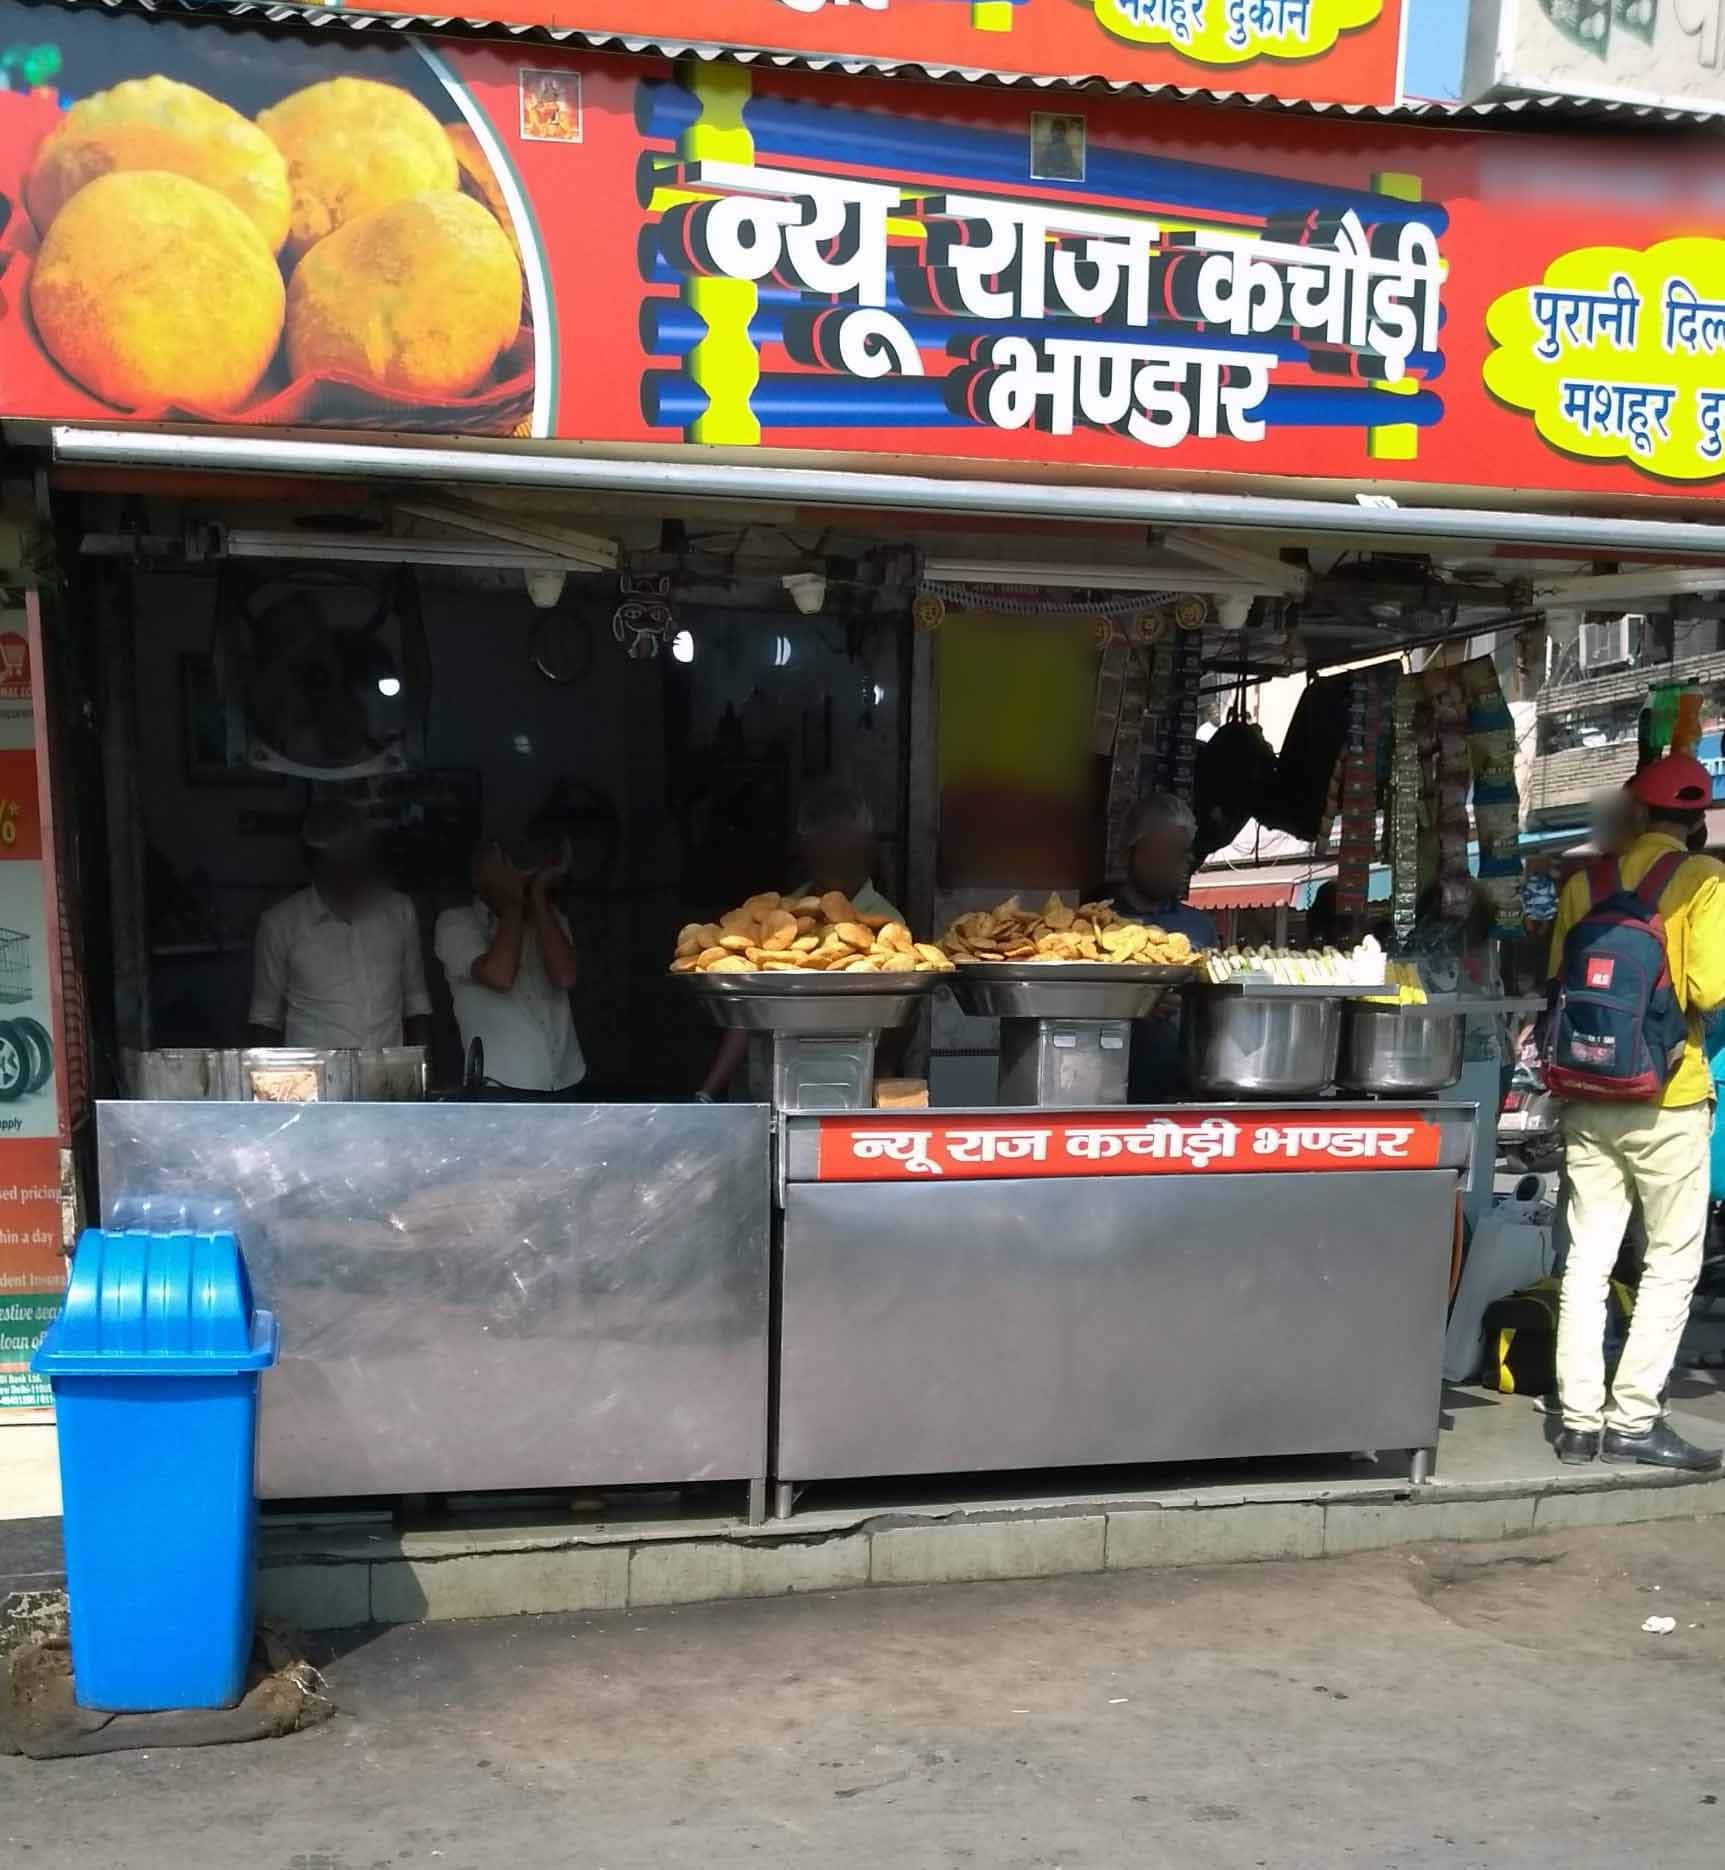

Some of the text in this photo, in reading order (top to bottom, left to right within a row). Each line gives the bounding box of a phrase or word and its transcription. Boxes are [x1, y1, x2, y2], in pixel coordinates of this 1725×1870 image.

[701, 160, 1441, 383] न्यू राज कचौड़ी
[1533, 275, 1641, 358] पुरानी
[988, 336, 1278, 449] भण्डार
[1563, 383, 1677, 452] मशहूर
[0, 1117, 22, 1131] pply
[851, 1117, 1413, 1174] न्यू राज कचौड़ी भण्डार
[21, 1232, 29, 1243] a
[32, 1227, 54, 1248] day
[0, 1332, 29, 1350] loan
